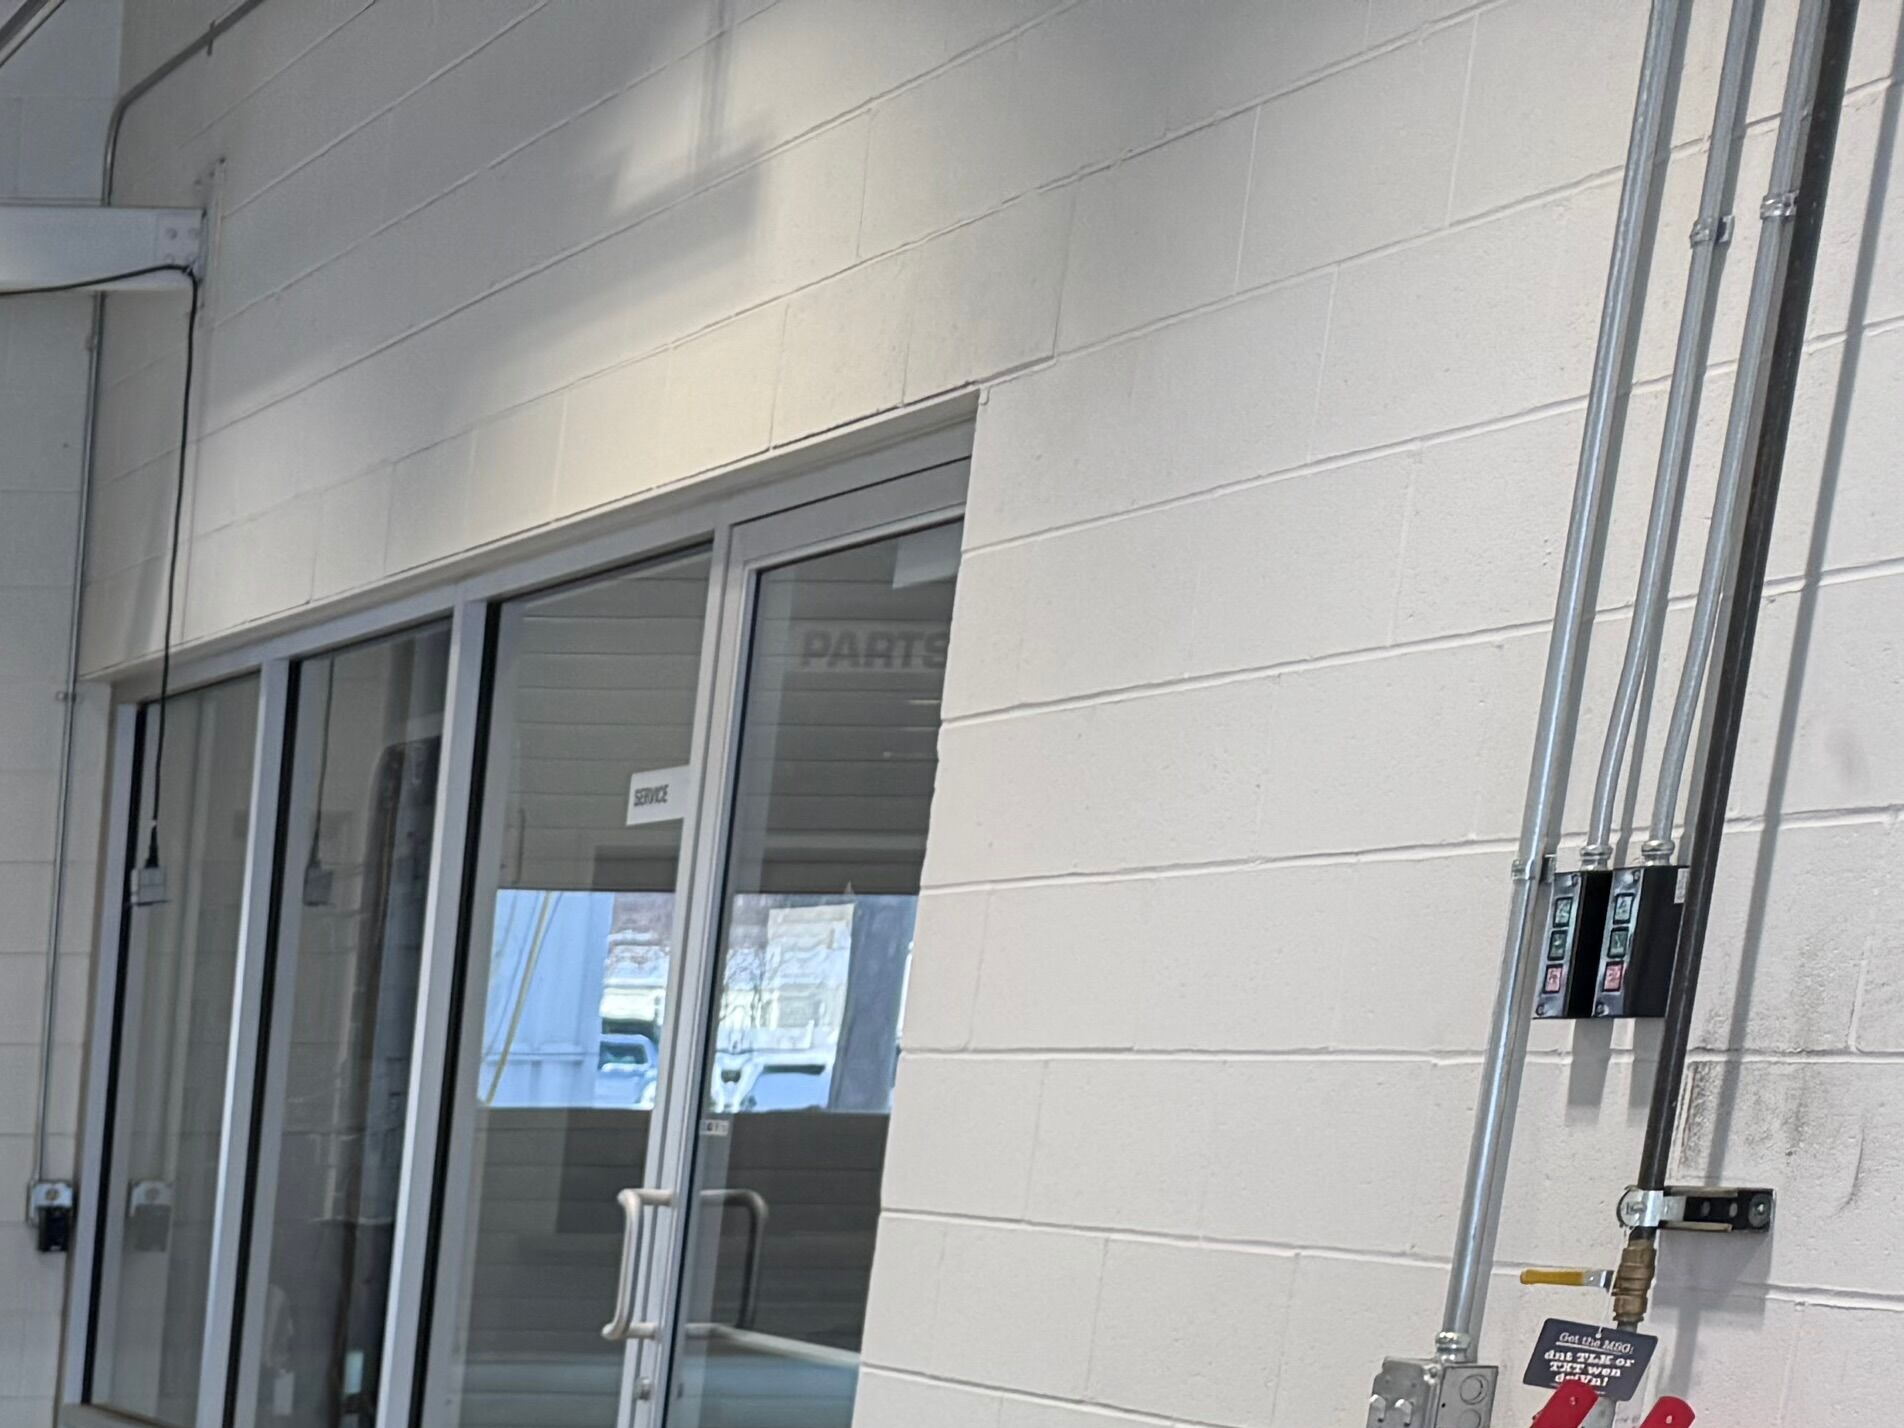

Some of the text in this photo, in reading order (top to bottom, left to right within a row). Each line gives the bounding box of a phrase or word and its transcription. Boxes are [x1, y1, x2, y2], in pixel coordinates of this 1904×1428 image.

[801, 630, 949, 669] PARTS
[1549, 1361, 1621, 1377] TXT wen
[1615, 1357, 1635, 1367] or
